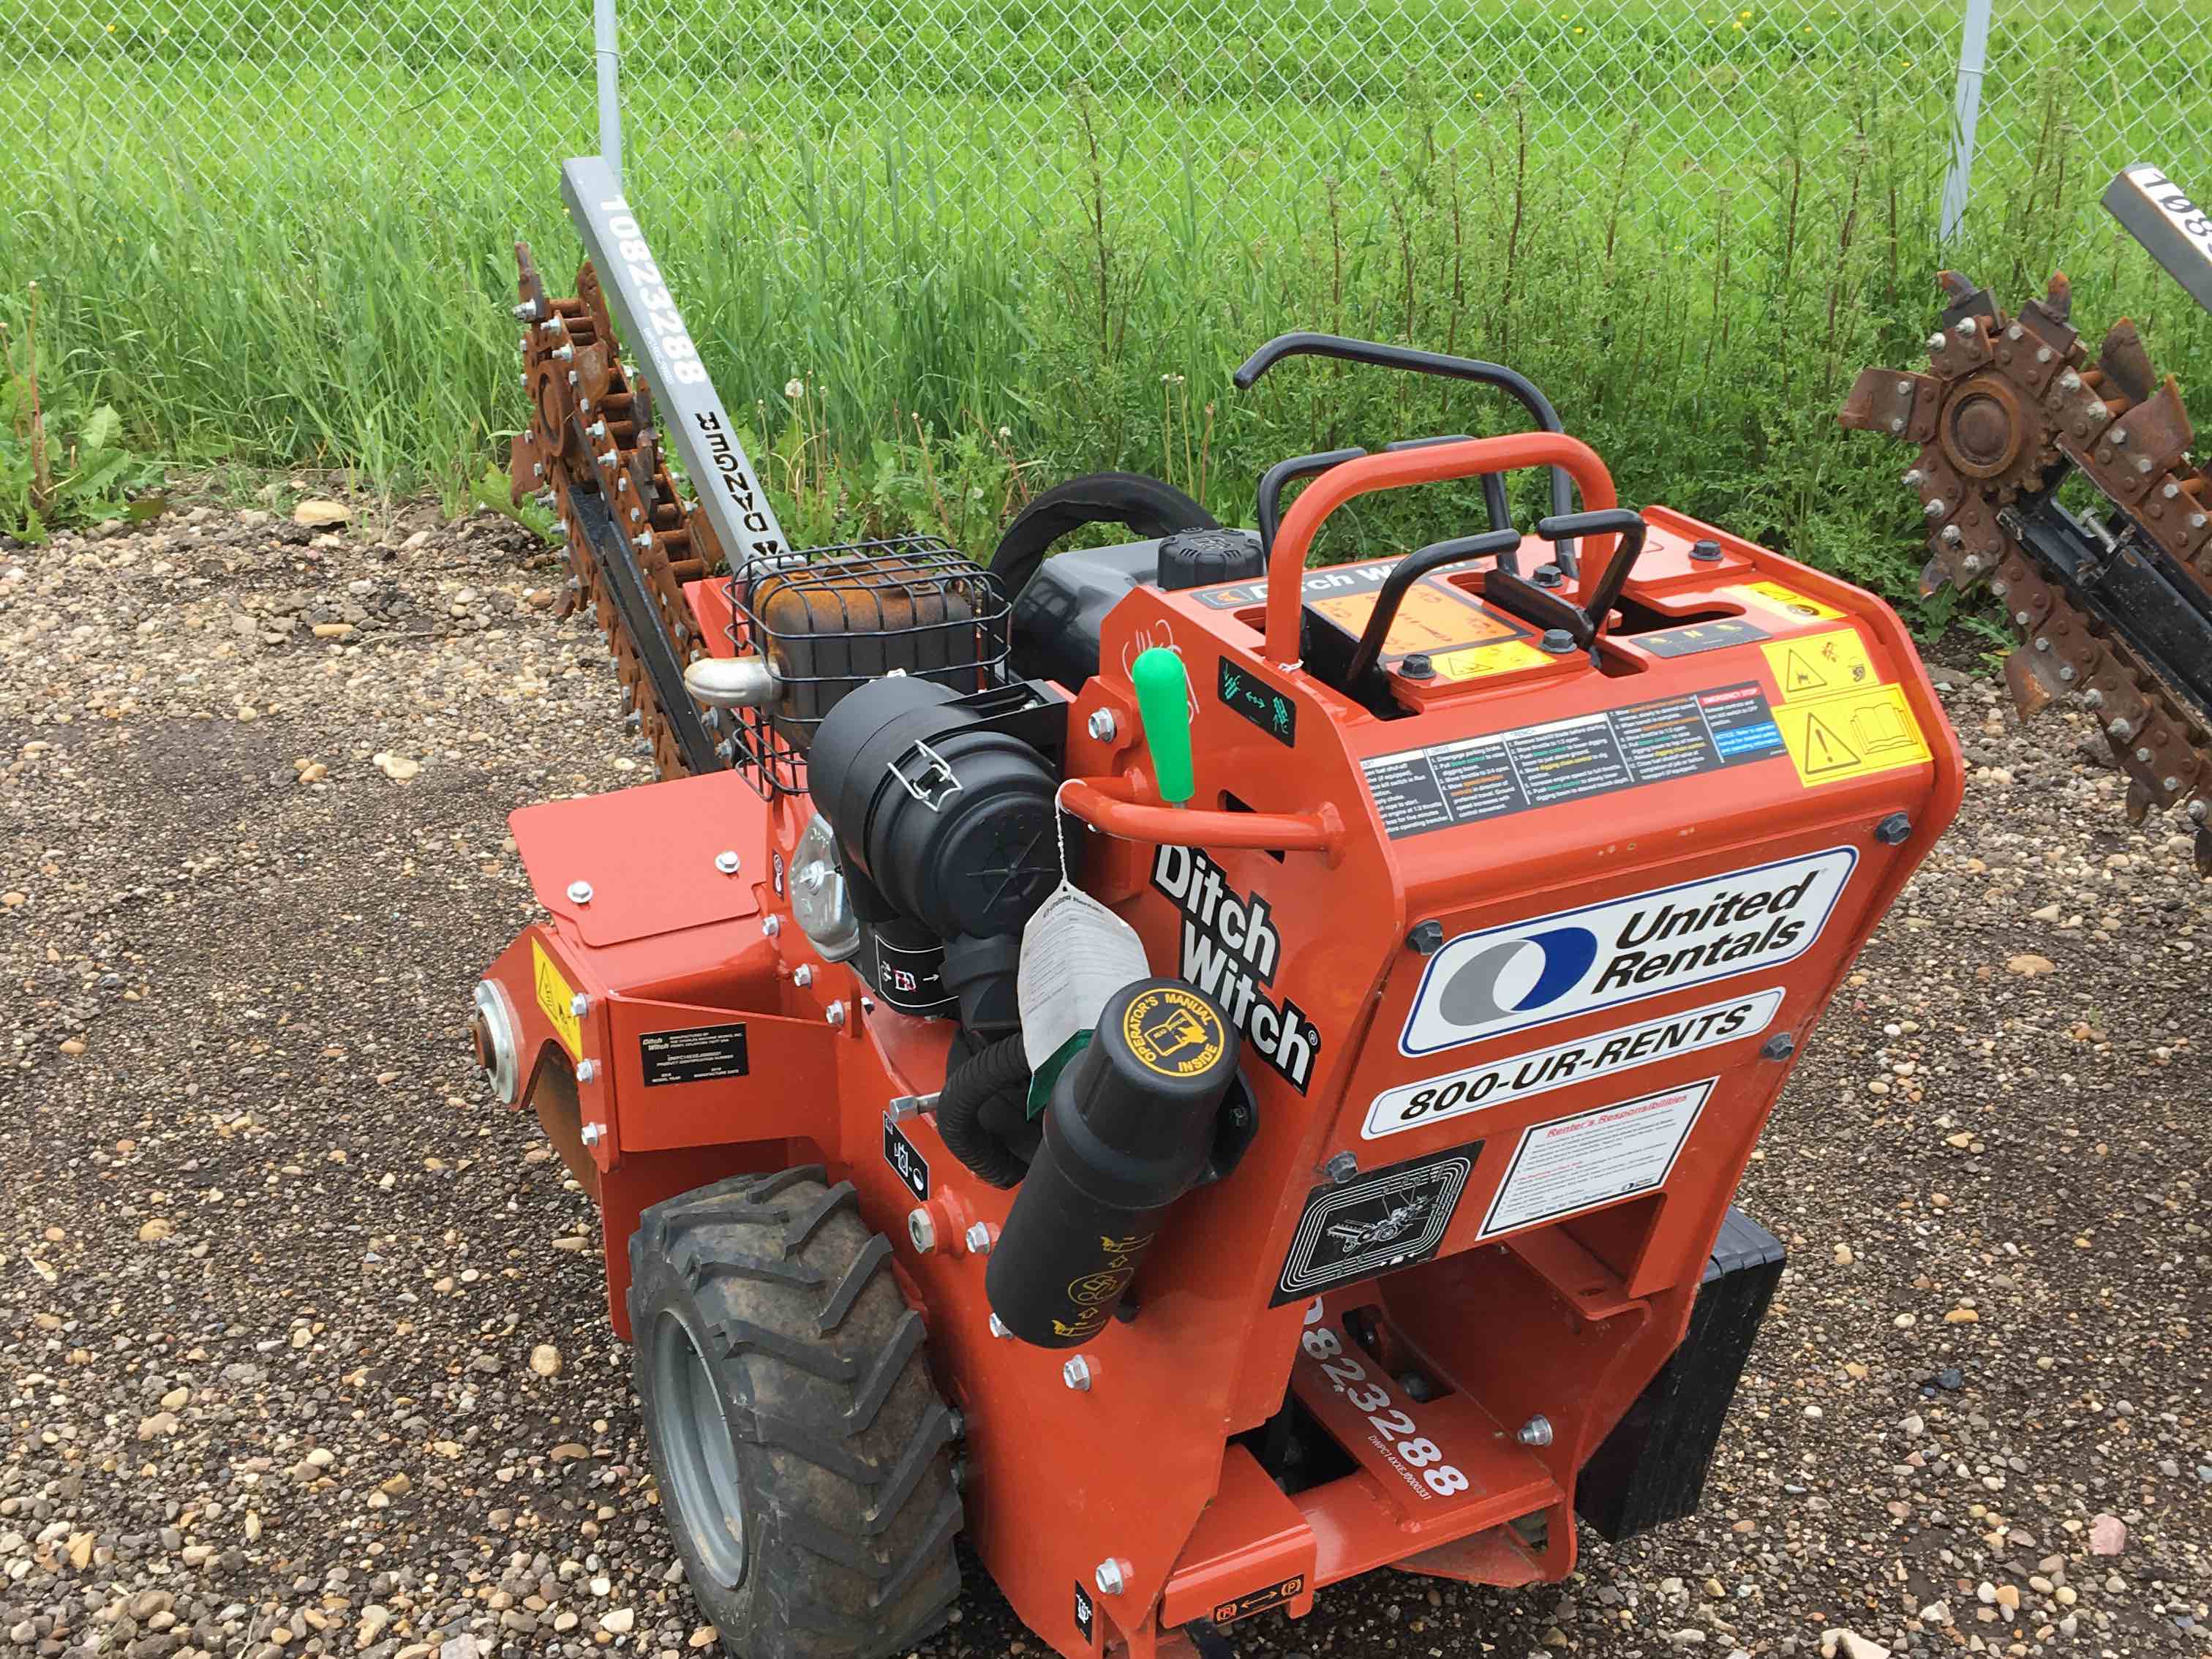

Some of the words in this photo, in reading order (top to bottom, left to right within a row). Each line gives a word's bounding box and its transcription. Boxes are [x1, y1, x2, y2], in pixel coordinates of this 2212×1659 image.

[600, 195, 707, 385] 10823288
[695, 410, 768, 533] DANGER
[1250, 573, 1354, 600] Dch
[1156, 844, 1276, 977] Ditch
[1615, 870, 1818, 949] United
[1592, 918, 1805, 995] Rentals
[1129, 996, 1159, 1062] OPERATOR'S
[1165, 993, 1212, 1026] MANUAL
[1178, 1043, 1218, 1072] INSIDE
[1400, 1004, 1753, 1121] 800-UR-RENTS
[1546, 1118, 1595, 1138] Renter's
[1598, 1095, 1688, 1125] Responsibilities
